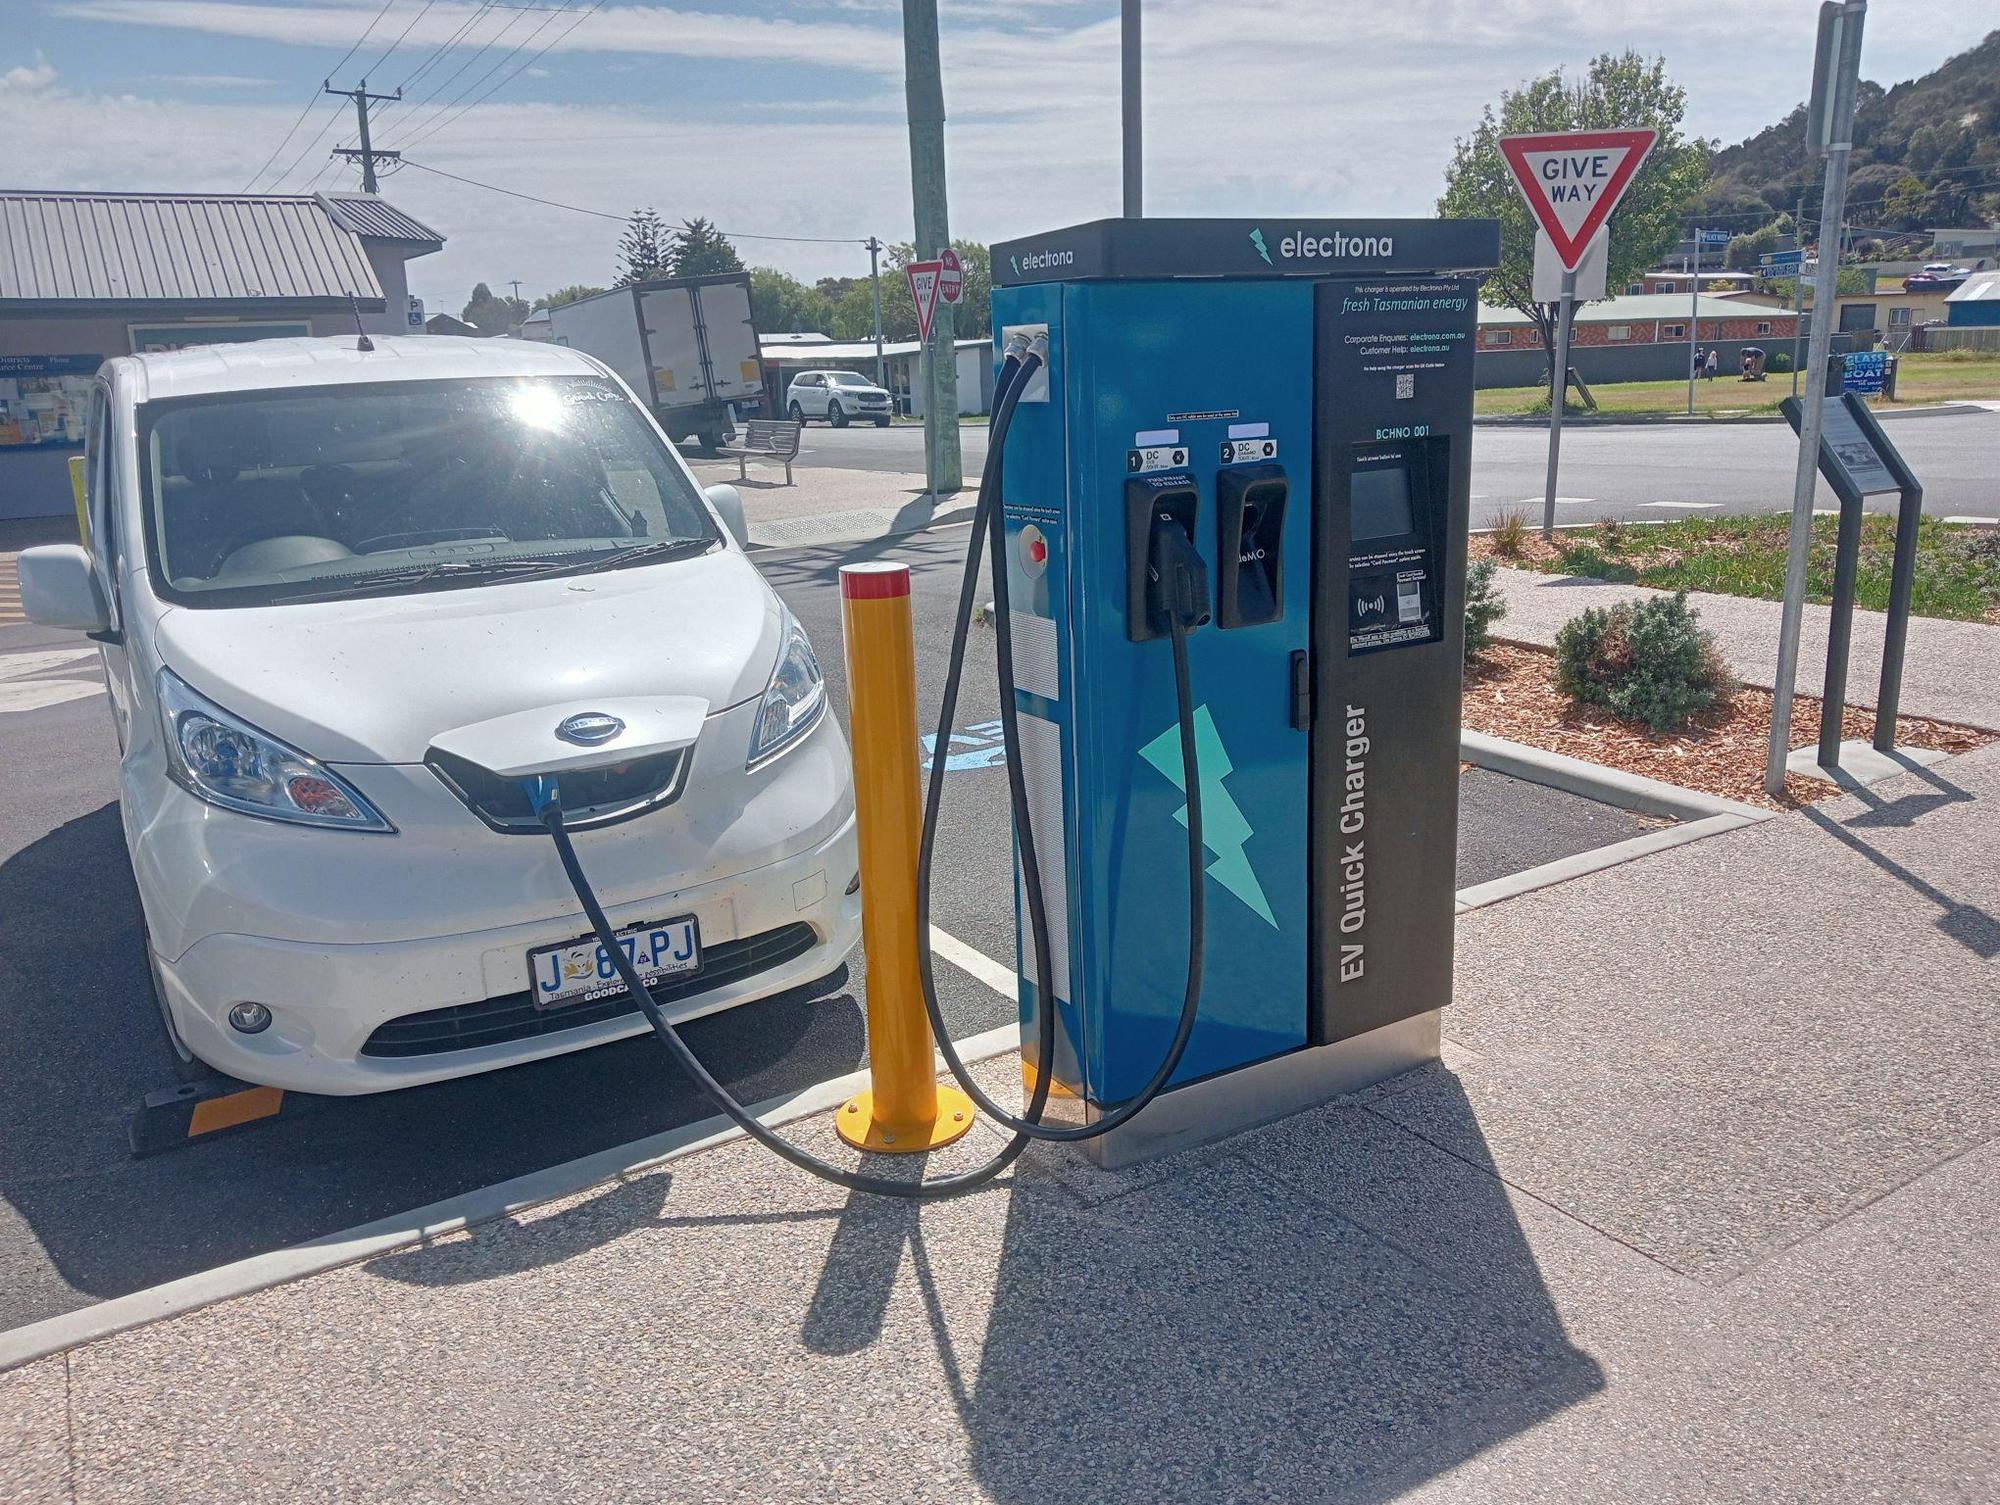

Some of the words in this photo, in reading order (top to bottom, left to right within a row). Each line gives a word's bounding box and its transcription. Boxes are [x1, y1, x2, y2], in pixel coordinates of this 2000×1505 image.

[1542, 156, 1608, 180] GIVE
[1551, 184, 1597, 203] WAY
[1280, 231, 1393, 258] electrona
[945, 257, 953, 267] NO
[1022, 250, 1074, 270] electrona
[916, 277, 932, 290] GIVE
[941, 284, 960, 295] ENTRY
[411, 301, 418, 311] P
[1341, 297, 1370, 314] fresh
[1374, 296, 1430, 312] Tasmanian
[1432, 298, 1469, 312] energy
[1344, 335, 1378, 344] Corporate
[1360, 346, 1391, 355] Customer
[1410, 345, 1450, 353] electrona.au
[1846, 353, 1883, 365] GLASS
[1844, 369, 1883, 378] BOAT
[1376, 427, 1410, 440] BCHNO
[1414, 425, 1429, 437] 001
[1223, 448, 1230, 459] 2
[1238, 443, 1250, 451] DC
[1130, 456, 1136, 467] 1
[1146, 451, 1159, 460] DC
[1340, 704, 1370, 834] Charger
[1340, 839, 1366, 933] Quick
[541, 954, 561, 993] J
[650, 925, 694, 967] PJ
[1340, 944, 1364, 983] EV
[550, 985, 592, 1001] Tasmania
[584, 983, 629, 1001] GOODCA
